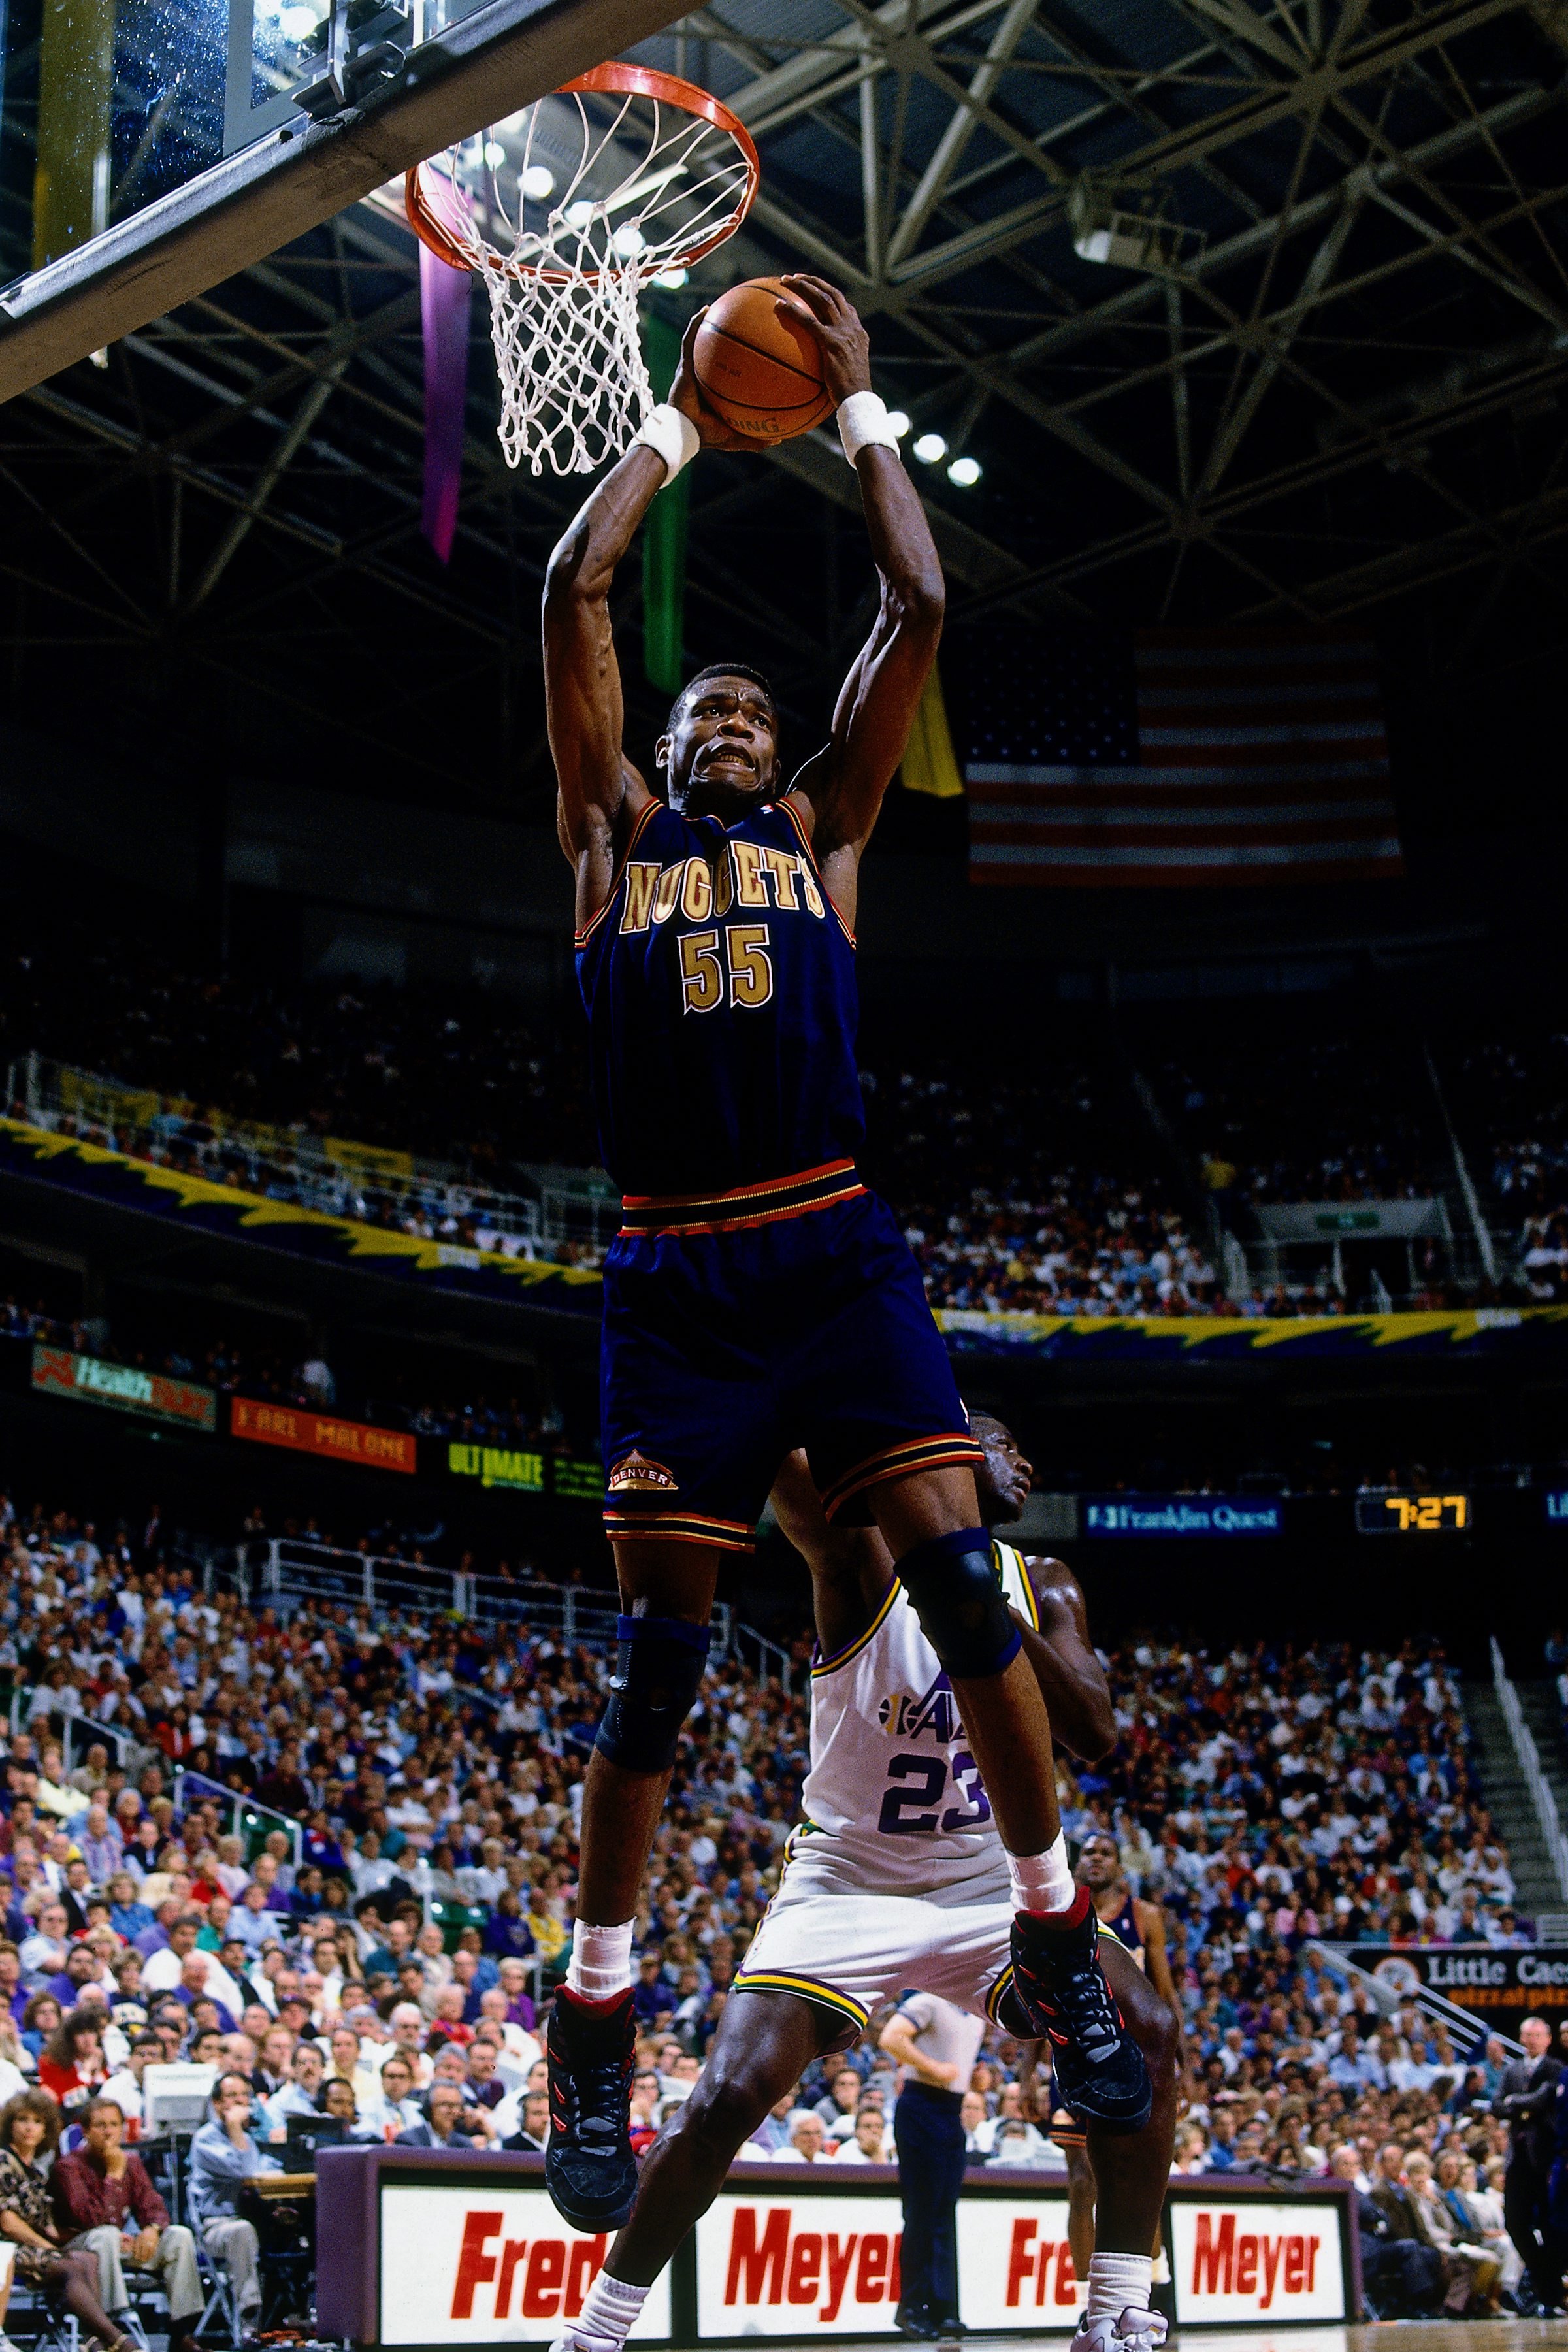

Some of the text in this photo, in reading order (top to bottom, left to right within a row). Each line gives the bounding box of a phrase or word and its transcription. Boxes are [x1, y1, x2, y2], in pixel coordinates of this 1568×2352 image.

[619, 840, 825, 934] NUGGETS
[678, 923, 773, 1015] 55
[612, 1467, 670, 1486] DENVER
[1385, 1495, 1467, 1531] 7:27
[878, 1752, 990, 1833] 23
[1427, 1956, 1508, 1986] Little
[450, 2210, 608, 2319] Fred
[1005, 2213, 1320, 2310] Fre Meyer
